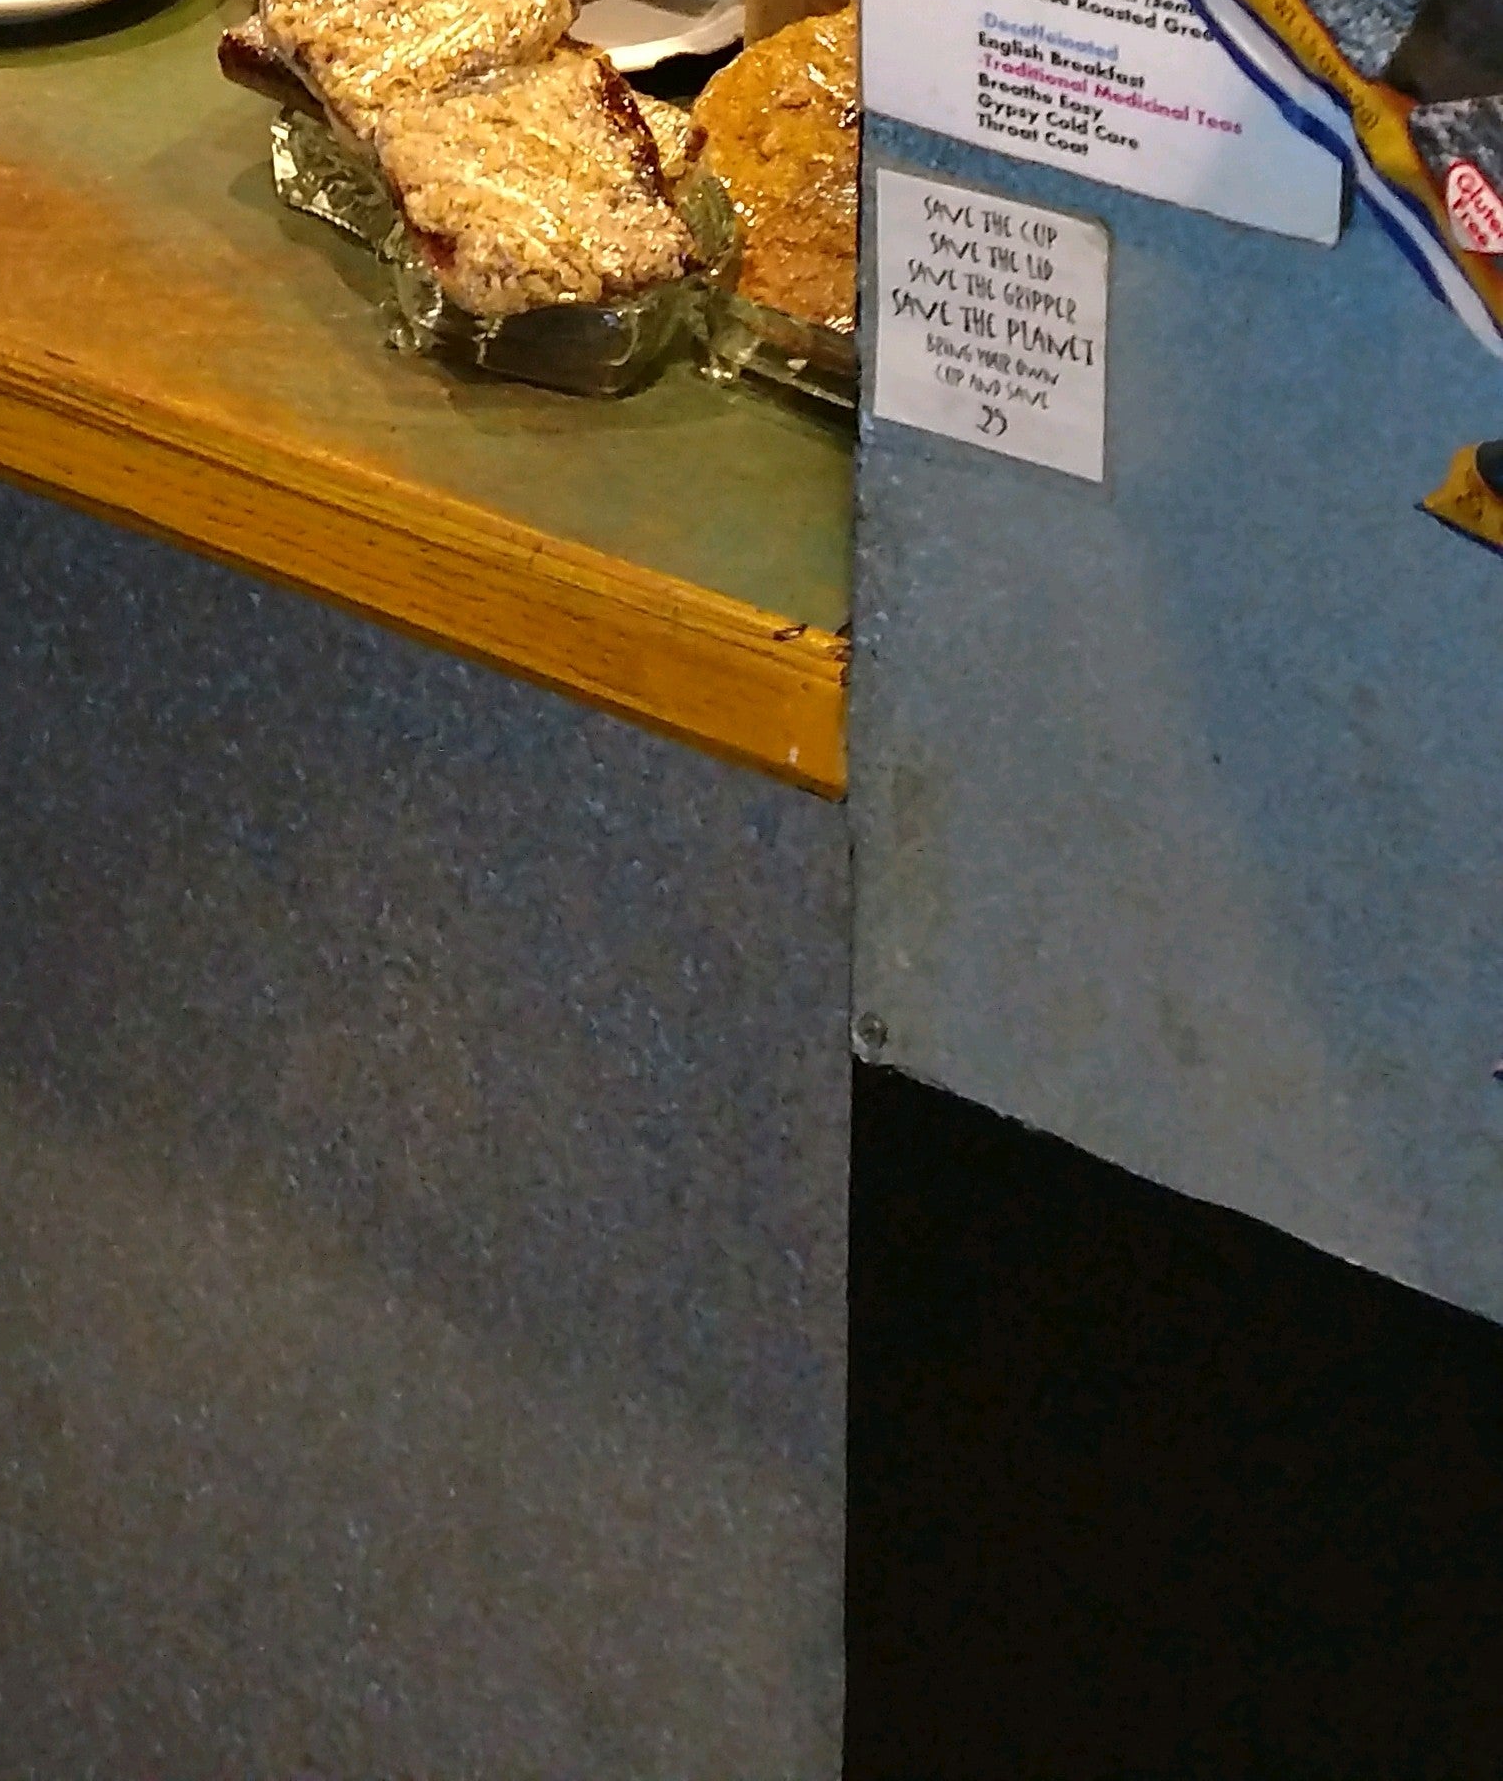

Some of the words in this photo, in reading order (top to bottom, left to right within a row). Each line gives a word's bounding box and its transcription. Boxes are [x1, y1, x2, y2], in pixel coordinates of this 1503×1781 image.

[978, 31, 1044, 63] English
[1050, 51, 1145, 89] Breakfast
[978, 73, 1052, 105] Breathe
[1060, 94, 1103, 121] Easy
[978, 93, 1038, 125] Gypsy
[1046, 111, 1088, 135] Cold
[1095, 124, 1139, 151] Care
[1094, 84, 1189, 121] Medicinal
[1197, 109, 1242, 134] Teas
[977, 113, 1038, 142] Throat
[1045, 131, 1089, 156] Coat
[923, 194, 974, 228] SAVE
[982, 210, 1012, 238] THE
[1020, 220, 1057, 250] CUP
[929, 232, 981, 263] SAVE
[987, 246, 1020, 273] THE
[1026, 254, 1053, 281] LID
[908, 259, 957, 291] SAVE
[964, 272, 996, 300] THE
[1004, 282, 1077, 325] GRIPPER
[892, 288, 953, 326] SAVE
[959, 307, 997, 338] THE
[1007, 318, 1094, 366] PLANET
[926, 333, 972, 363] BRING
[935, 363, 965, 387] CUP
[969, 373, 1001, 397] AND
[1006, 381, 1049, 410] SAVE
